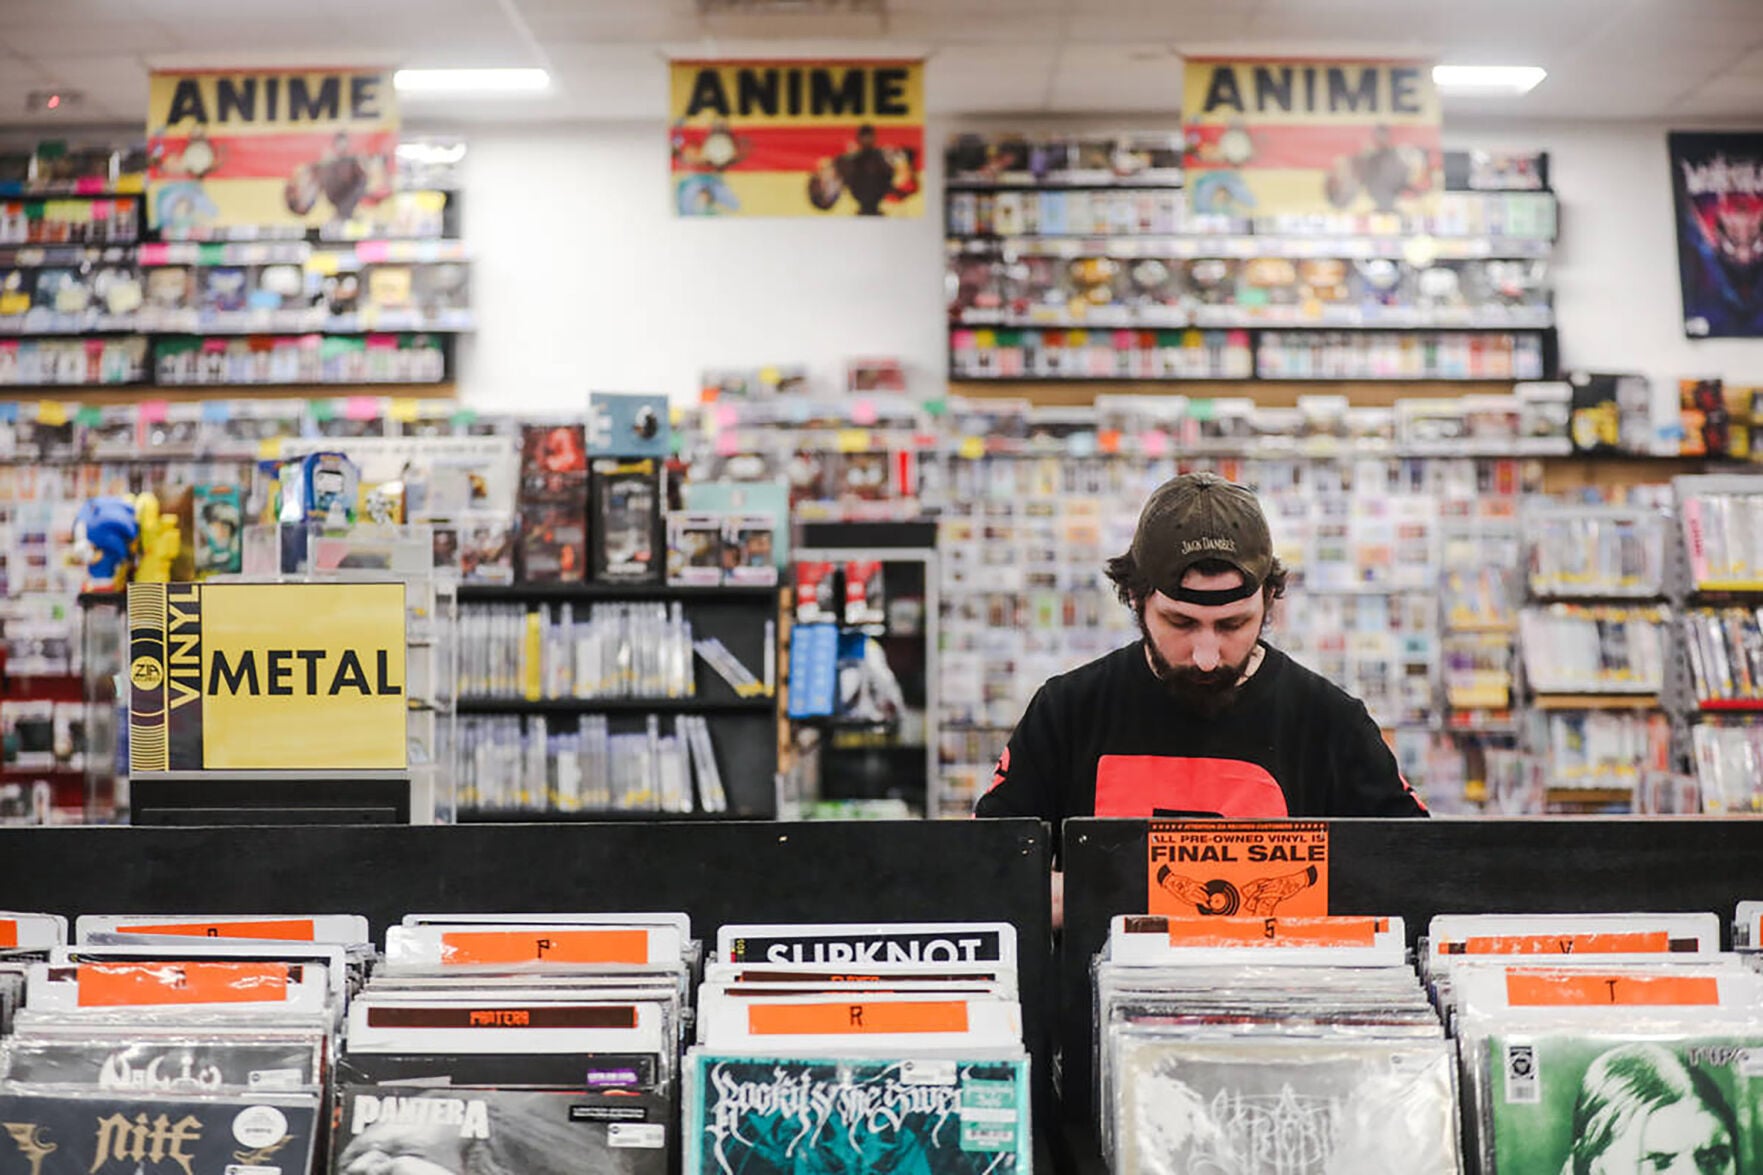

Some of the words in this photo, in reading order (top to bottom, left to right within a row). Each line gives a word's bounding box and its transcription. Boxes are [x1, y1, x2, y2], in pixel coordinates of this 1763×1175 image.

[168, 76, 382, 125] ANIME
[687, 68, 909, 117] ANIME
[1204, 65, 1421, 113] ANIME
[169, 585, 201, 710] VINYL
[134, 663, 161, 678] ZIA
[207, 650, 402, 696] METAL
[1152, 834, 1176, 843] ALL
[1180, 834, 1265, 843] PRE-OWNED
[1267, 834, 1307, 843] VINYL
[1311, 834, 1326, 843] IS
[1151, 845, 1238, 862] FINAL
[1247, 845, 1326, 862] SALE
[536, 939, 550, 959] P
[1604, 979, 1618, 1002] T
[469, 1010, 530, 1025] PANTERA
[849, 1005, 863, 1027] R
[351, 1094, 490, 1139] PANTERA
